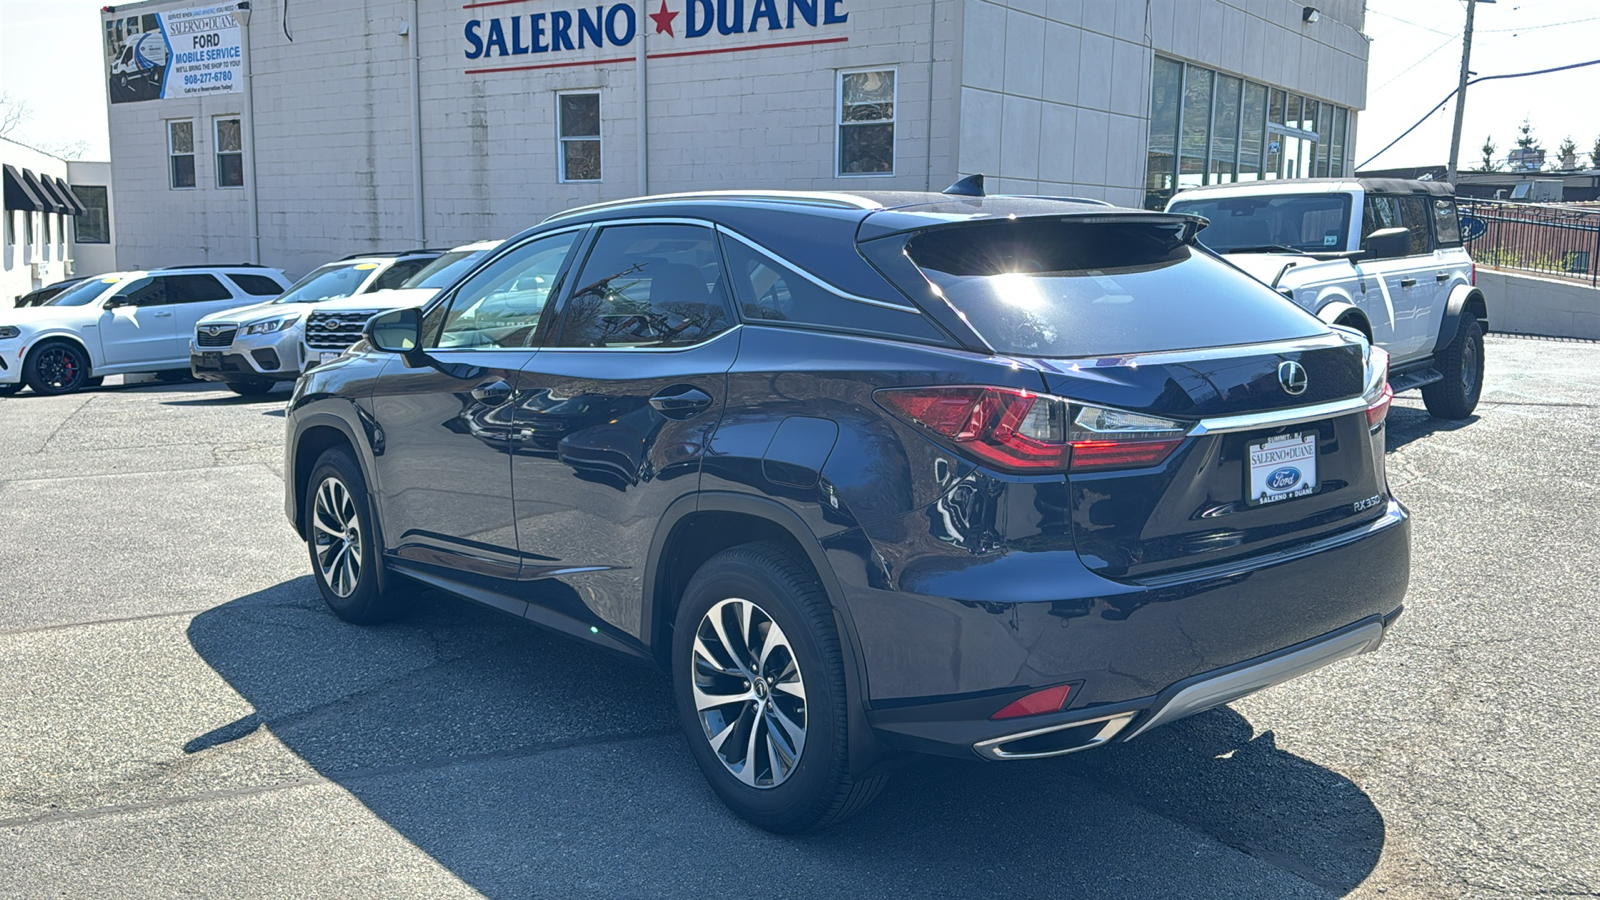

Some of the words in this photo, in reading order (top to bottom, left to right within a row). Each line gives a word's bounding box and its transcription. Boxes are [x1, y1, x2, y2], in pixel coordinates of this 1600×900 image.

[170, 19, 205, 34] SALERNO
[464, 3, 636, 60] SALERNO
[685, 0, 849, 39] DUANE
[193, 33, 220, 49] FORD
[175, 50, 205, 64] MOBILE
[206, 46, 240, 61] SERVICE
[184, 70, 232, 85] 908-277-6780
[1252, 449, 1287, 465] SALERNO
[1290, 444, 1314, 459] DUANE
[1273, 470, 1295, 488] Ford
[1259, 493, 1287, 505] SALERNO
[1294, 487, 1314, 498] DUANE
